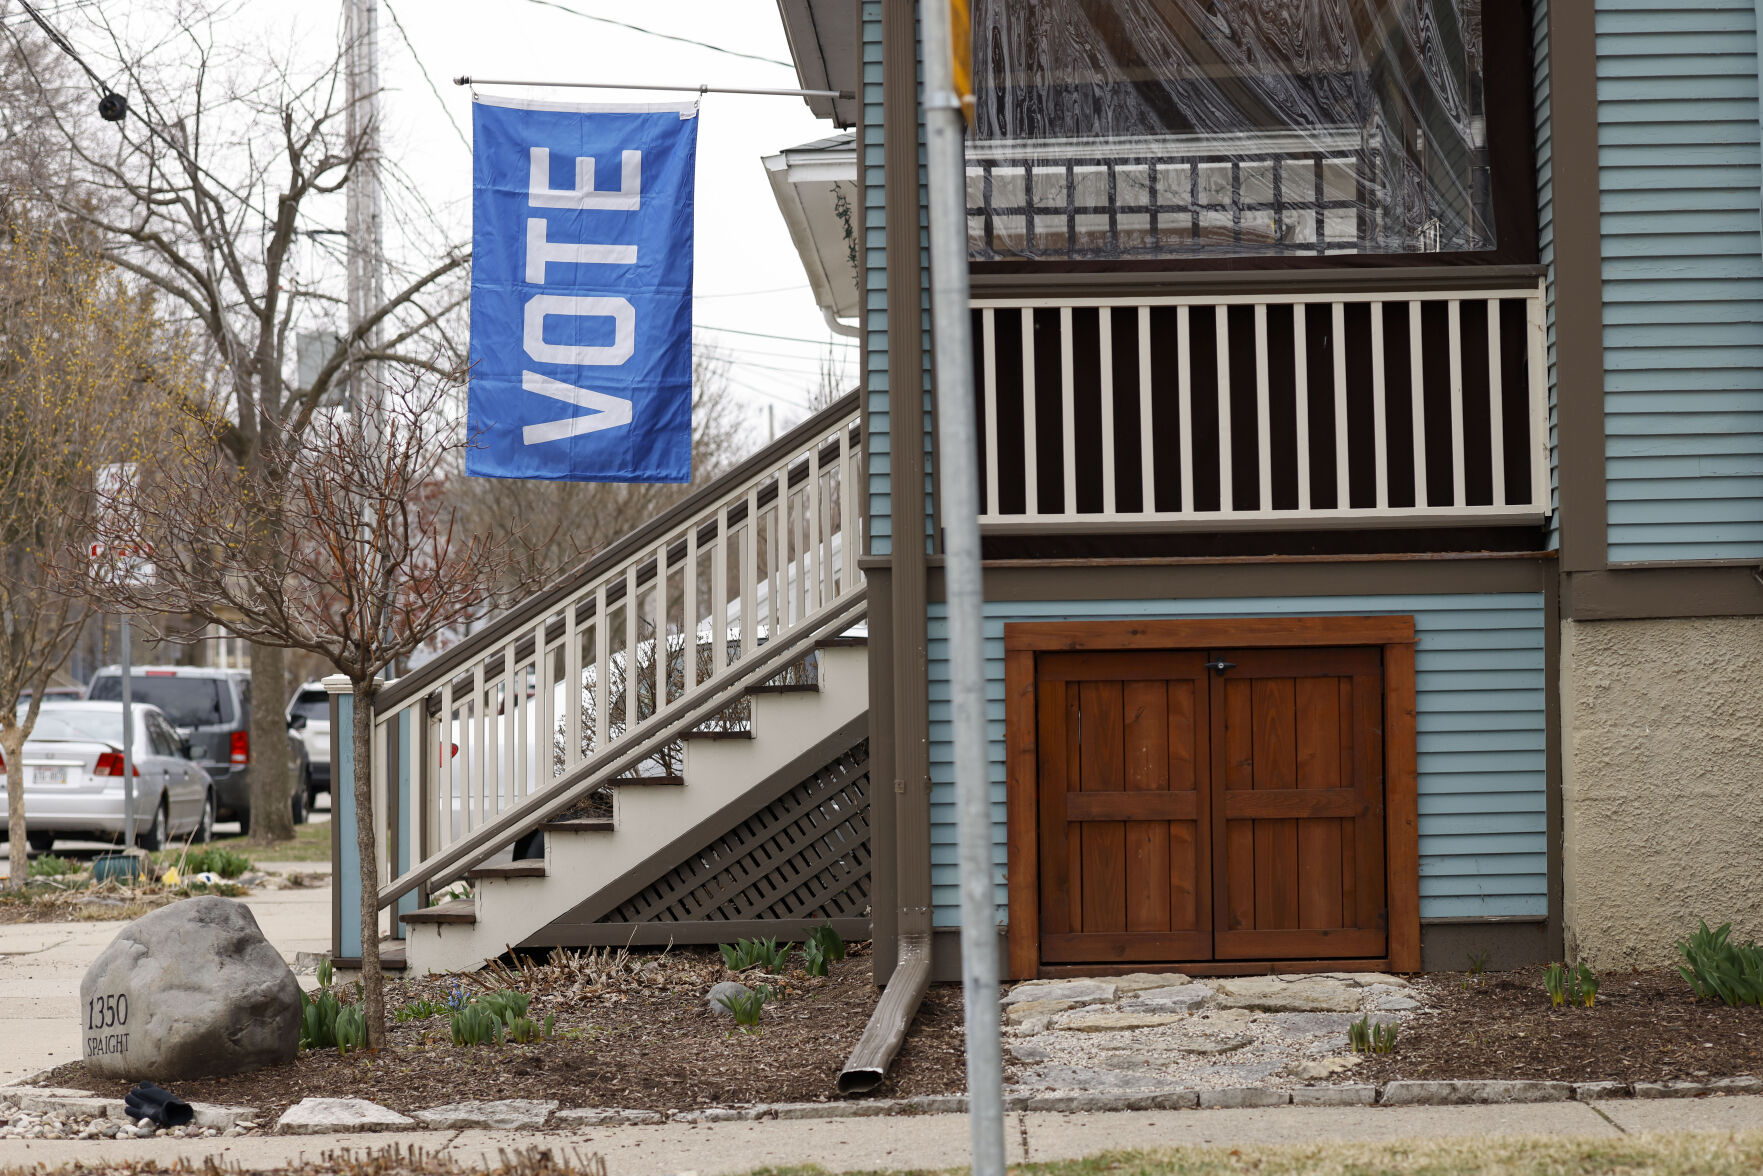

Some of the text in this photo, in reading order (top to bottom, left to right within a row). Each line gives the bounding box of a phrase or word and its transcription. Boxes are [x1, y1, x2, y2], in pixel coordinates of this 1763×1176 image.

[522, 147, 642, 445] VOTE
[88, 993, 128, 1030] 1350
[87, 1033, 130, 1057] SPAIGHT
